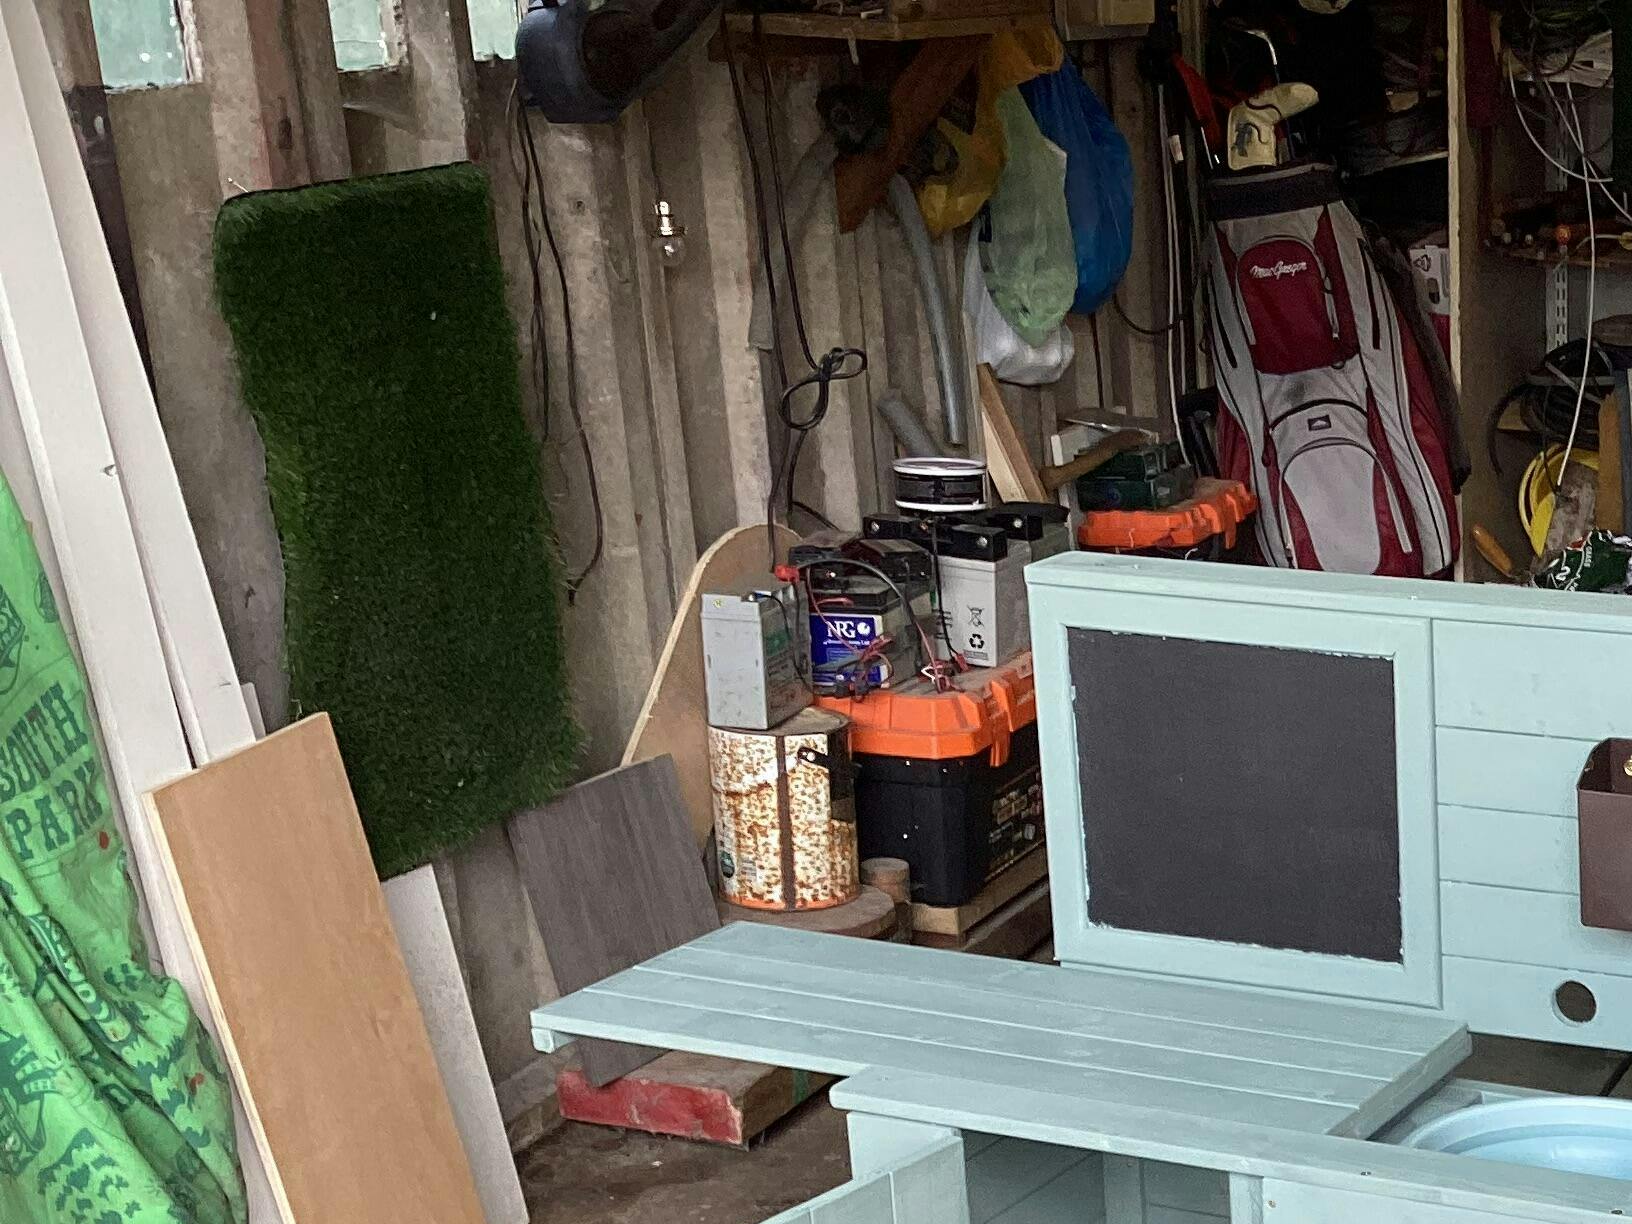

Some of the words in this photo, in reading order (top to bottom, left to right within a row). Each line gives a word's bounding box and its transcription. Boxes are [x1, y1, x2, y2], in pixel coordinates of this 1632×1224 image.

[827, 620, 856, 639] NRG
[0, 683, 88, 801] SOUTH
[6, 757, 103, 861] PARK
